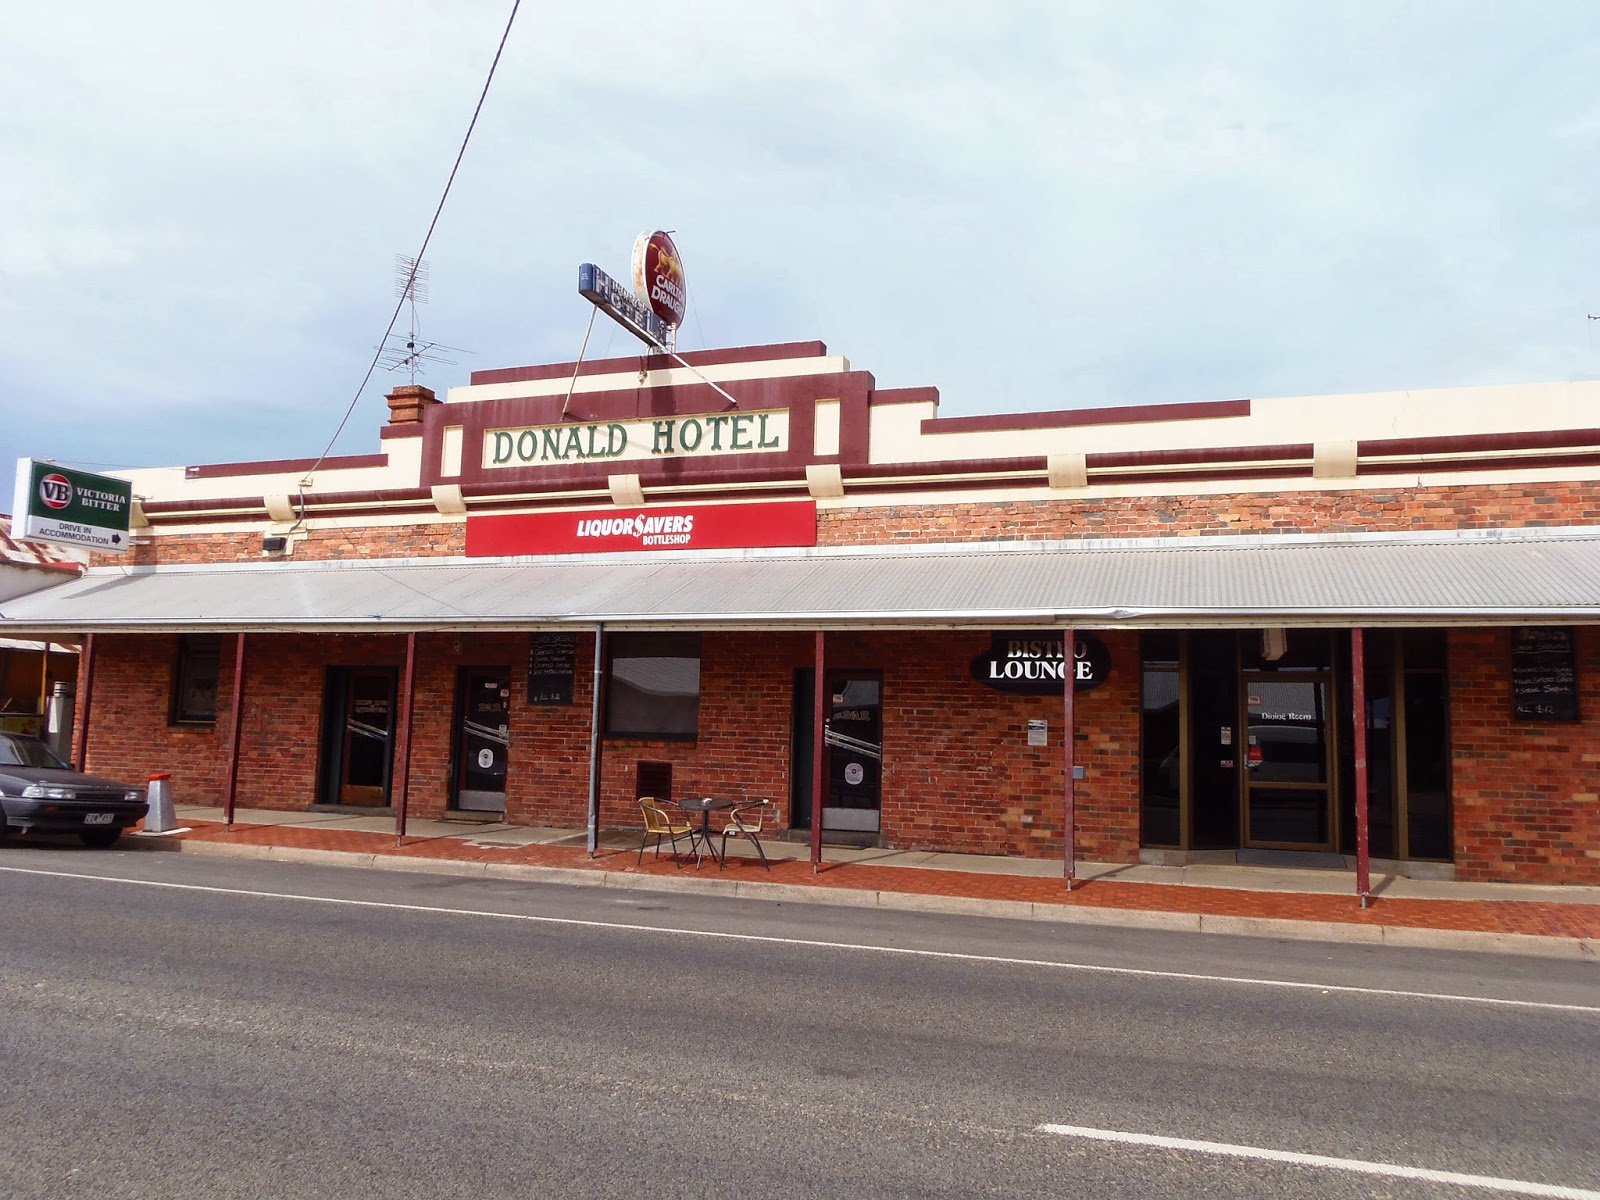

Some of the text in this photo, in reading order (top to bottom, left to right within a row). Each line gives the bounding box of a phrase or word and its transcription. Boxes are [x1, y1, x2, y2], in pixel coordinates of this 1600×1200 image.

[493, 413, 780, 464] DONALD HOTEL
[43, 481, 69, 501] VB
[76, 487, 126, 504] VICTORIA
[81, 497, 120, 512] BITTER
[59, 522, 92, 534] DRIVE IN
[39, 528, 109, 545] ACCOMMODATION
[643, 534, 692, 546] BOTTLESHOP
[1261, 711, 1312, 721] Dining Room
